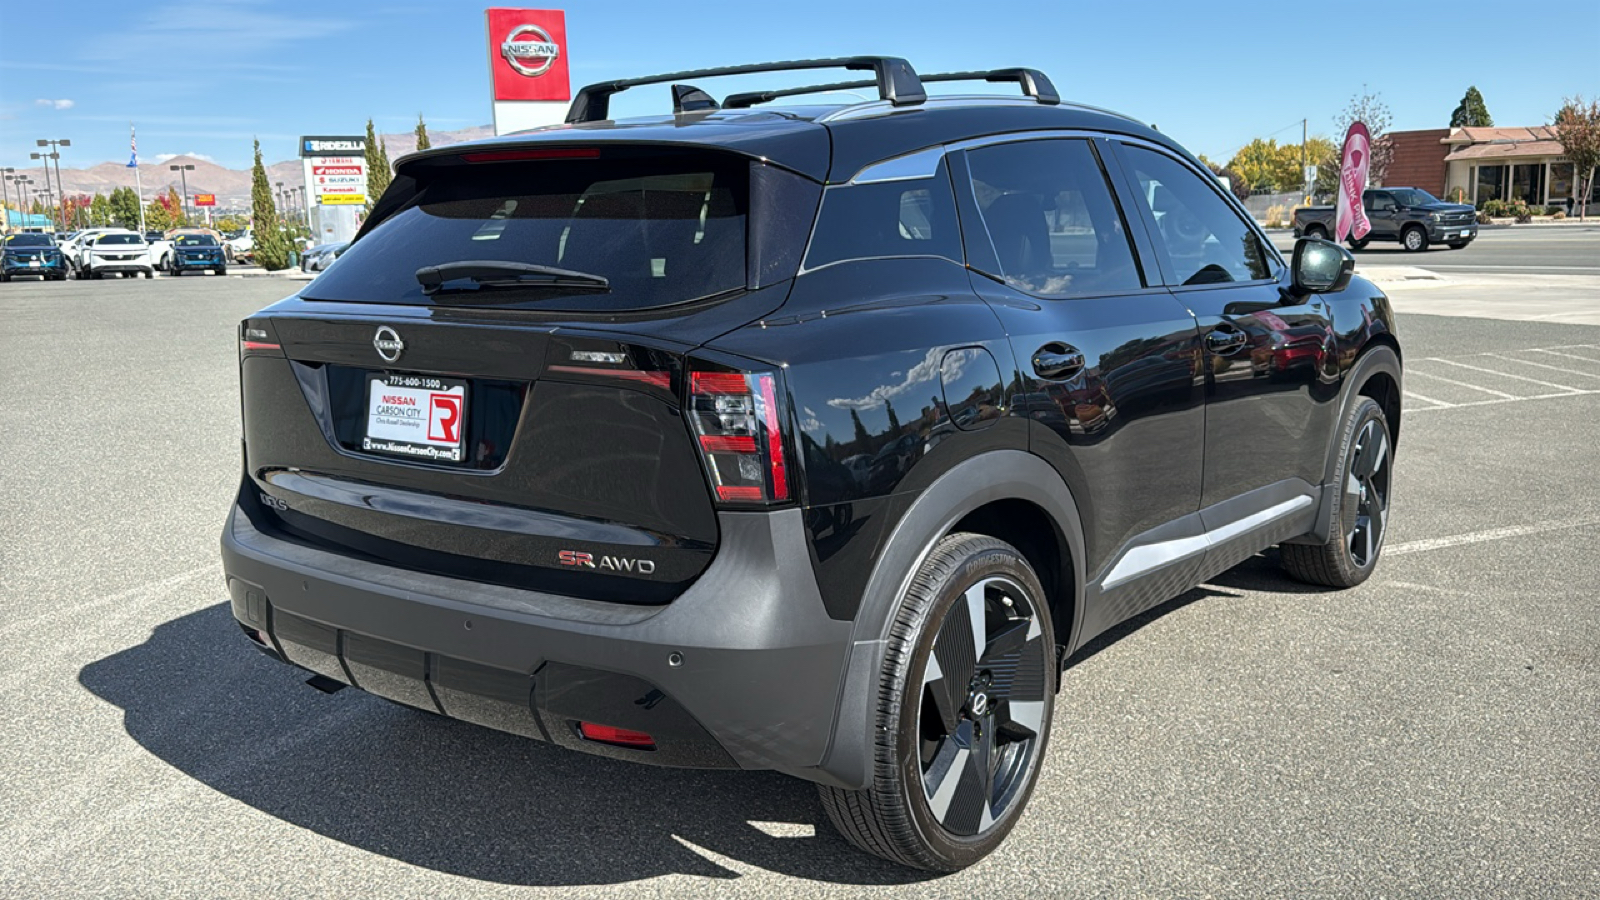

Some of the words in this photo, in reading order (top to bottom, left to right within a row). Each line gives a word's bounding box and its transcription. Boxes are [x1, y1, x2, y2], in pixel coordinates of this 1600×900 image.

[508, 45, 555, 54] NISSAN
[319, 140, 366, 151] RIDEZILLA
[1343, 166, 1357, 202] THINK
[1353, 203, 1367, 231] PINK
[389, 376, 441, 388] 775-600-1500
[382, 395, 416, 406] NISSAN
[376, 405, 405, 416] CARSON
[406, 408, 421, 418] CITY
[559, 550, 596, 568] SR
[599, 556, 655, 574] AWD
